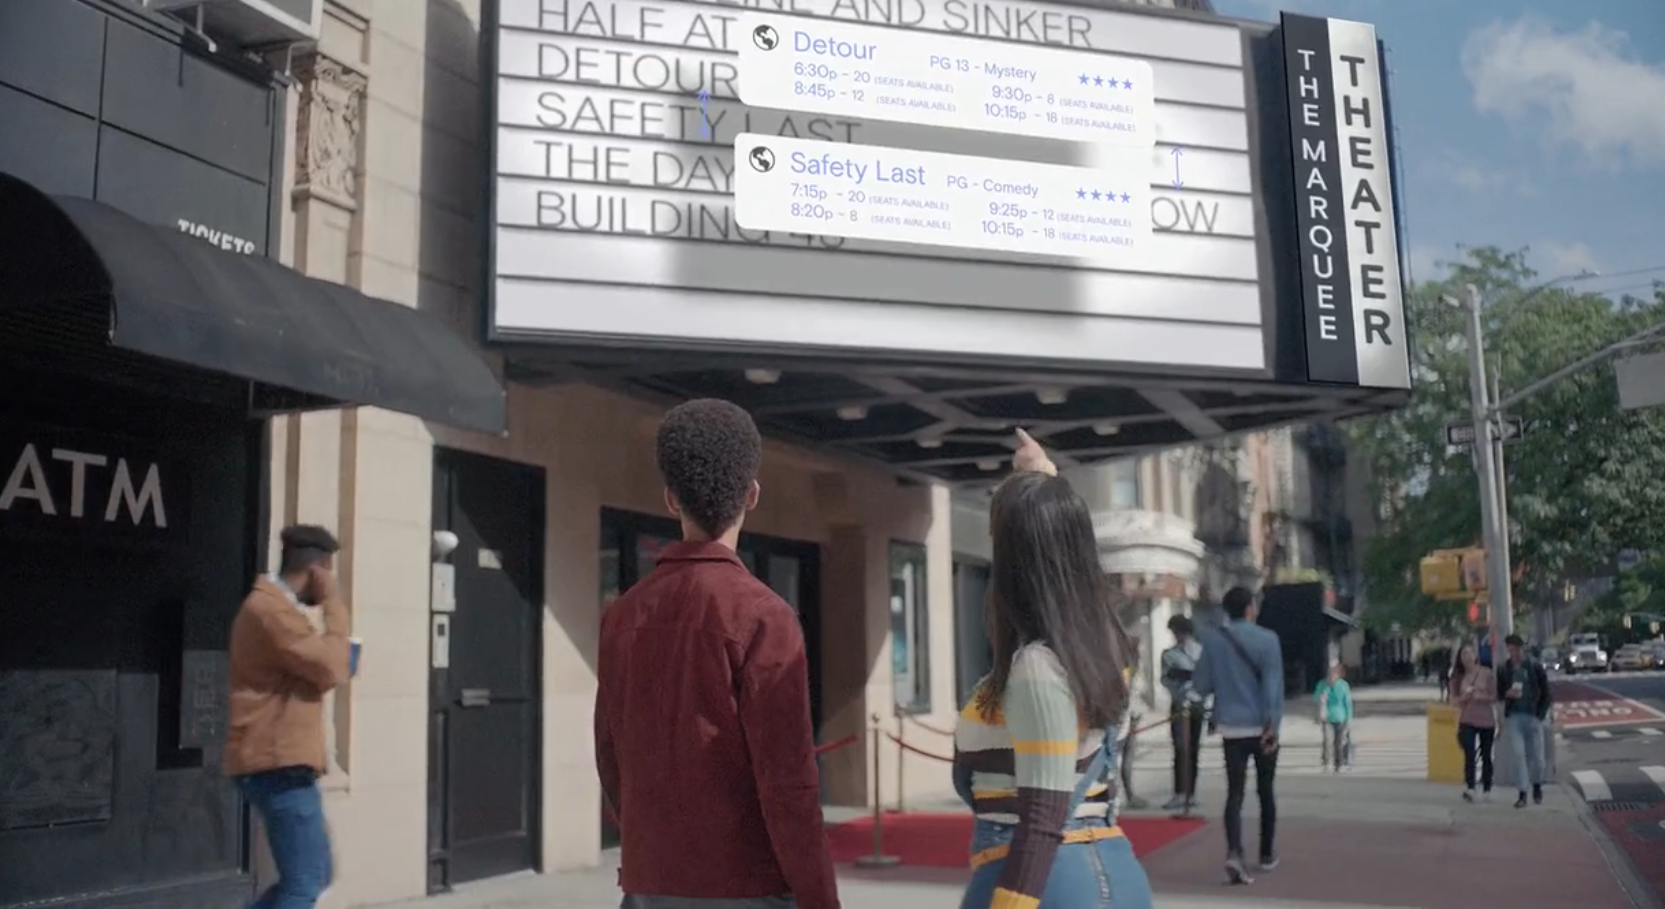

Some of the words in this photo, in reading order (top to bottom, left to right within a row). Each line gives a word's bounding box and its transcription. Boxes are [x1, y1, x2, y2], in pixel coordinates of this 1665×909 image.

[539, 0, 665, 42] HALF
[683, 13, 738, 50] AT
[943, 1, 1092, 48] SINKER
[538, 43, 739, 97] DETOUR
[1297, 49, 1321, 127] THE
[536, 91, 727, 143] SAFETY
[534, 140, 631, 184] THE
[1340, 55, 1392, 346] THEATER
[1302, 138, 1338, 340] MARQUEE
[0, 442, 168, 529] ATM
